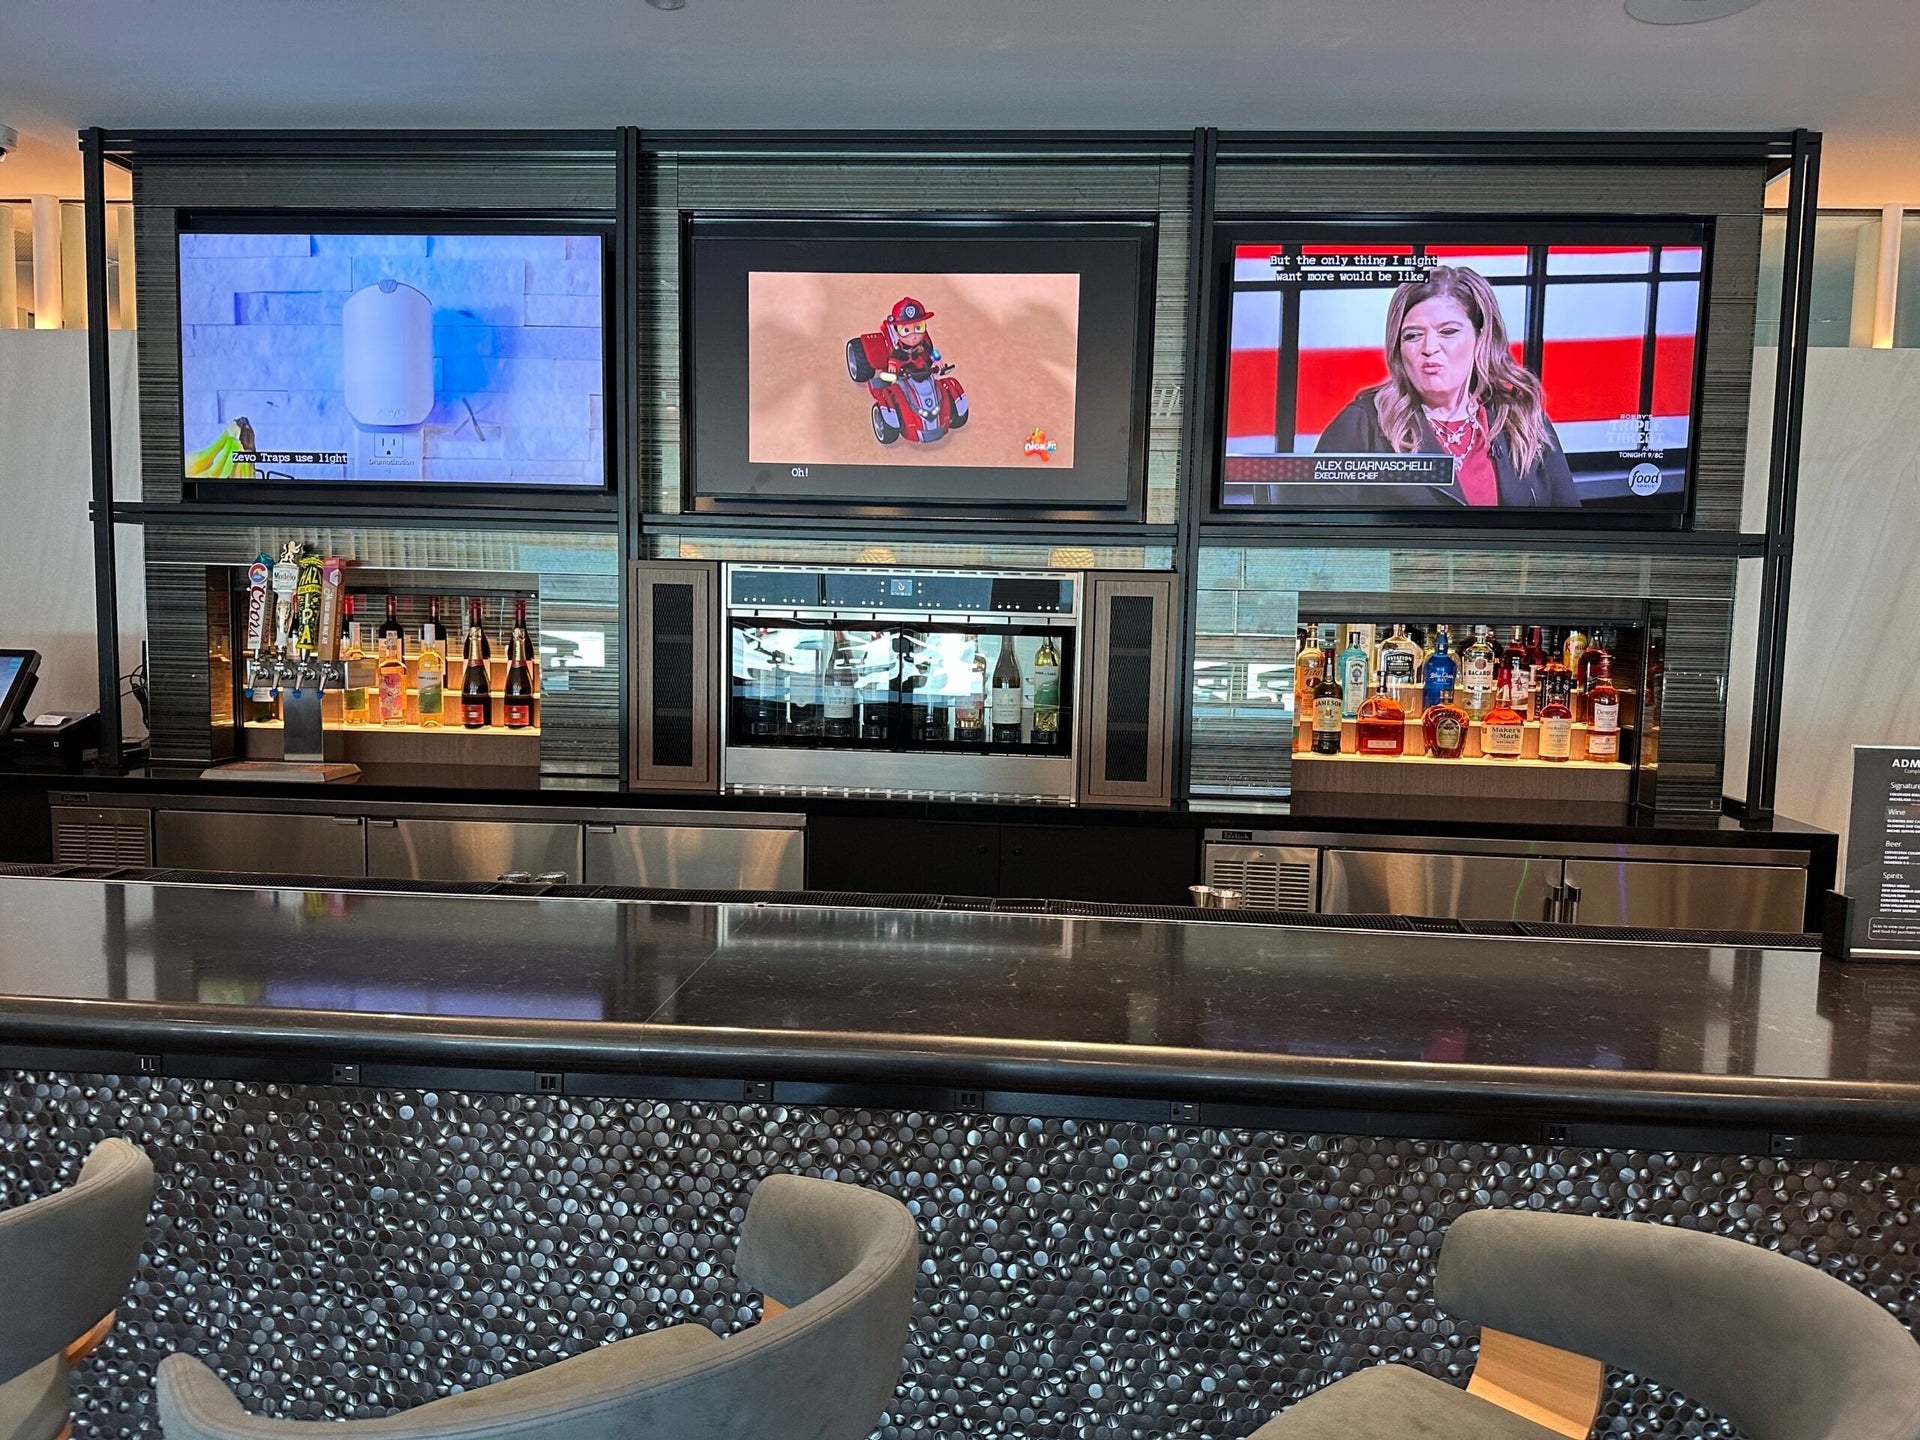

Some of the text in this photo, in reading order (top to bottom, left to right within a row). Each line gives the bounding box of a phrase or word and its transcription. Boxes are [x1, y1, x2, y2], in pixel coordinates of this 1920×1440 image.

[1270, 256, 1290, 265] But
[1296, 256, 1316, 265] the
[1321, 256, 1348, 267] only
[1354, 256, 1387, 267] thing
[1404, 256, 1438, 267] might
[1276, 273, 1302, 281] want
[1340, 272, 1372, 281] would
[1378, 272, 1392, 281] be
[1398, 272, 1429, 283] like,
[232, 453, 256, 462] Zevo
[260, 453, 290, 464] Traps
[319, 453, 347, 464] light
[1314, 461, 1432, 471] ALEX GUARNASCHELLI
[791, 467, 809, 477] Oh!
[1314, 472, 1378, 480] EXECUTIVE CHEF
[1630, 470, 1660, 488] food
[249, 586, 266, 639] Coors
[1304, 668, 1322, 676] Tito
[1596, 708, 1616, 716] Dewar
[1888, 808, 1906, 816] Wine
[1885, 840, 1902, 848] Beer
[1882, 872, 1904, 880] Spirits
